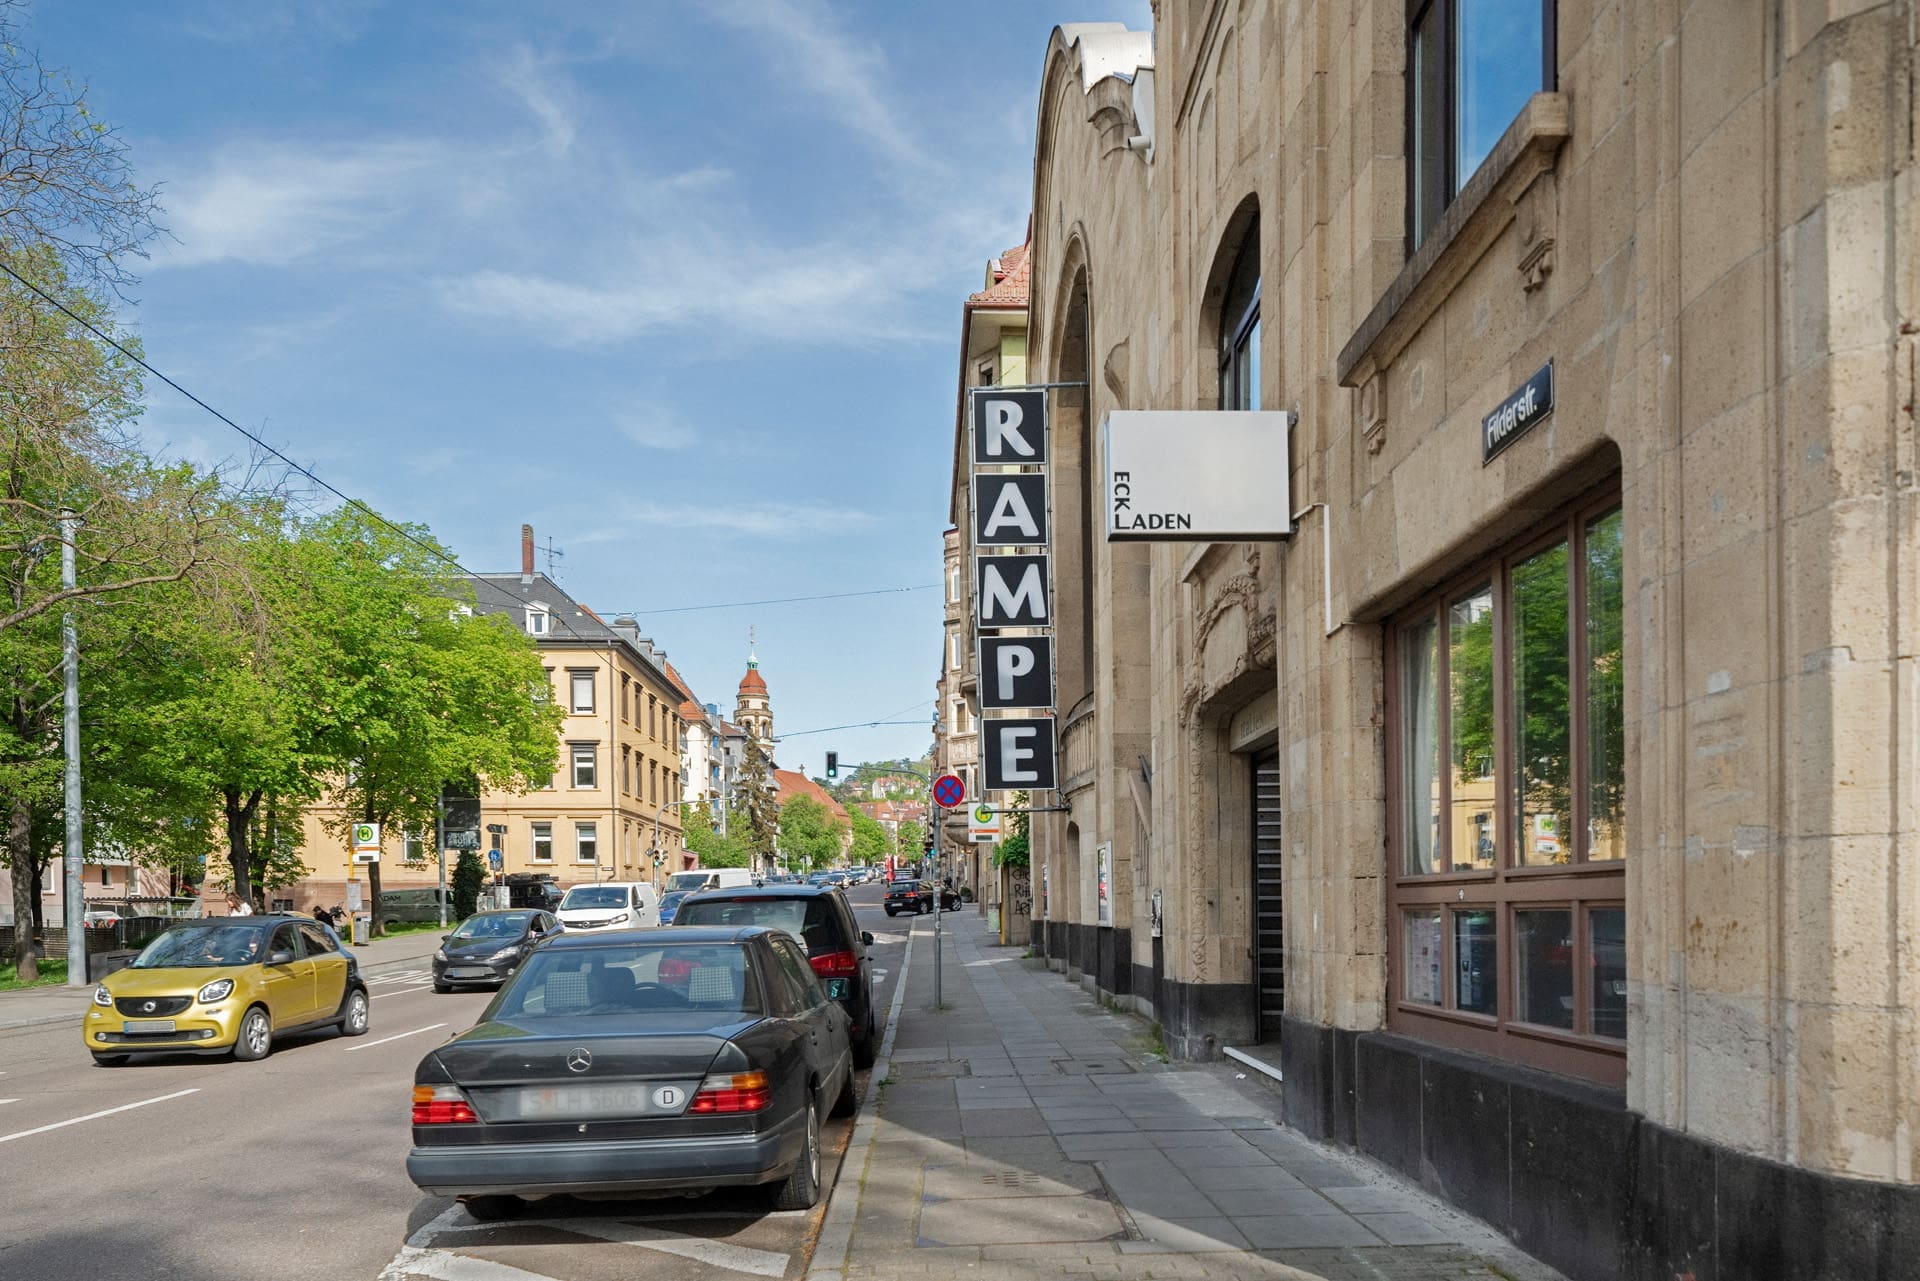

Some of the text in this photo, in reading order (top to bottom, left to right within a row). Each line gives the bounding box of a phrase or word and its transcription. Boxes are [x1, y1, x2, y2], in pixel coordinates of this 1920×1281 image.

[1487, 384, 1538, 449] Filderstr.
[1114, 471, 1130, 512] ECK
[1115, 513, 1191, 530] LADEN
[982, 400, 1046, 782] RAMPE
[663, 1090, 674, 1104] D
